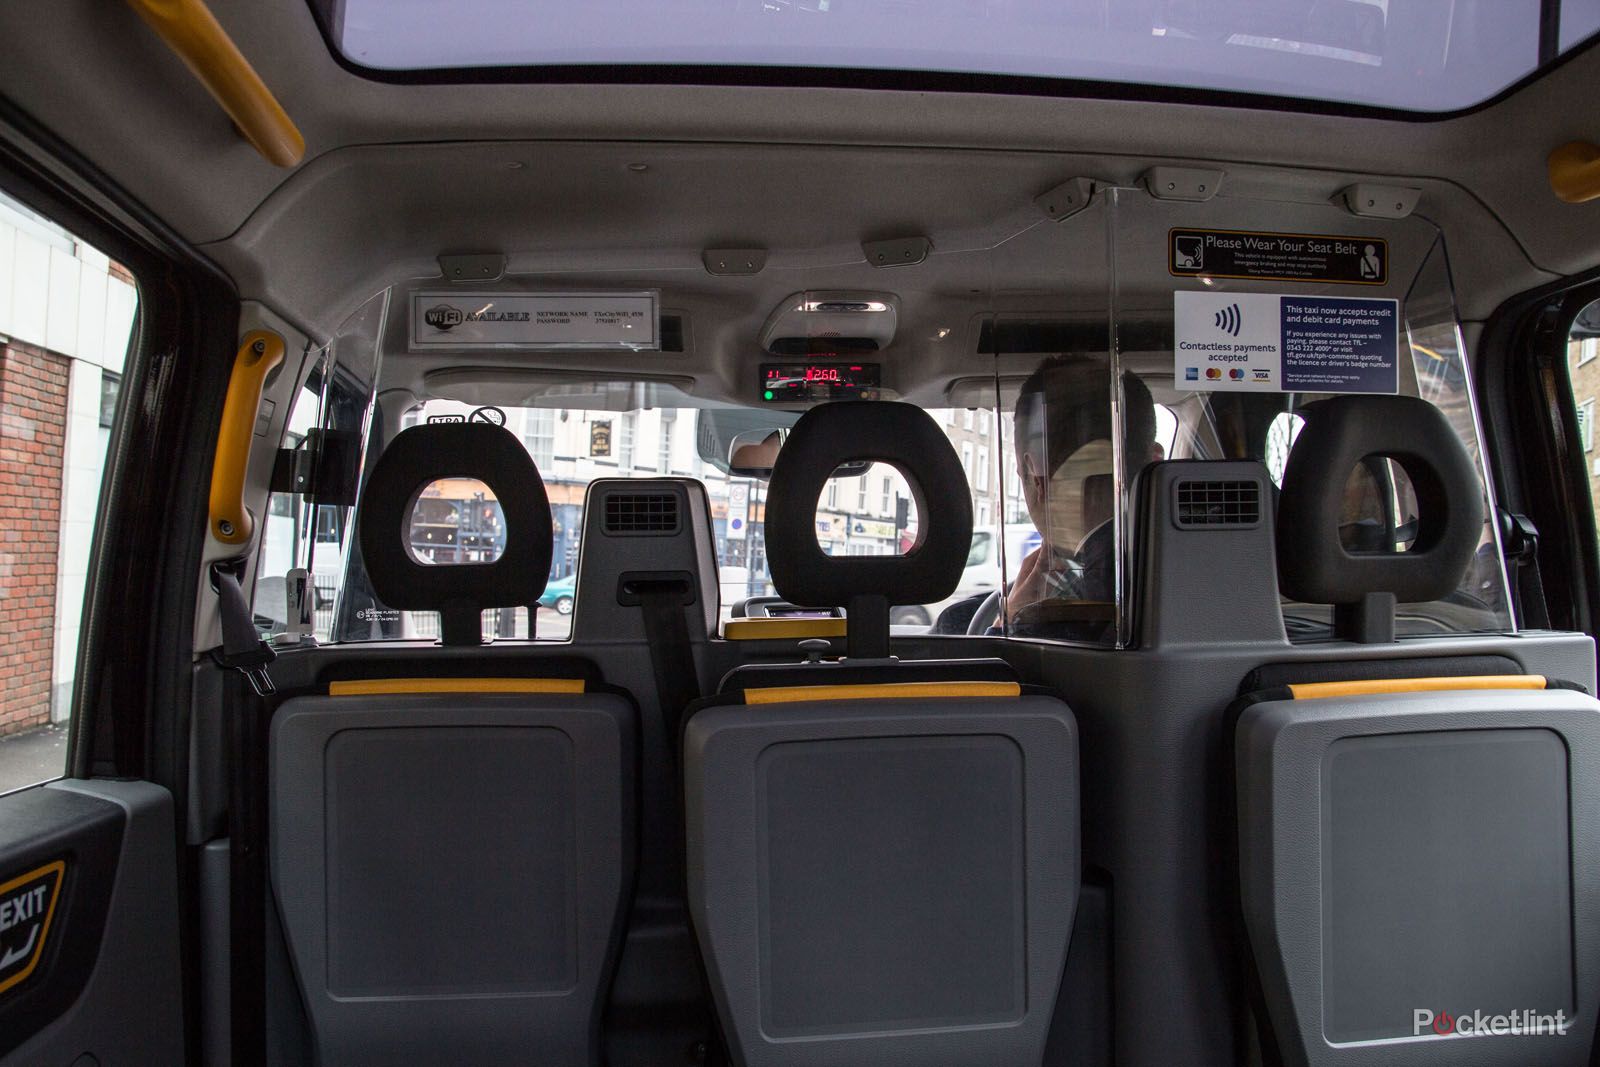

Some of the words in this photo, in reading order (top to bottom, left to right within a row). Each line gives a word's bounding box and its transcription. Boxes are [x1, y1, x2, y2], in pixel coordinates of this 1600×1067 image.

[1206, 236, 1242, 248] Please
[1244, 238, 1275, 250] Wear
[1278, 239, 1304, 252] Your
[1307, 241, 1332, 254] Seat
[1335, 242, 1358, 255] Belt
[1286, 306, 1302, 314] This
[1304, 306, 1318, 314] taxi
[1338, 308, 1368, 316] accepts
[466, 312, 530, 322] AVAILABLE
[1324, 316, 1340, 324] card
[1342, 318, 1380, 326] payments
[1304, 331, 1336, 339] experience
[1180, 342, 1232, 351] Contactless
[1234, 344, 1276, 353] payments
[1208, 354, 1248, 363] accepted
[0, 884, 46, 932] EXIT
